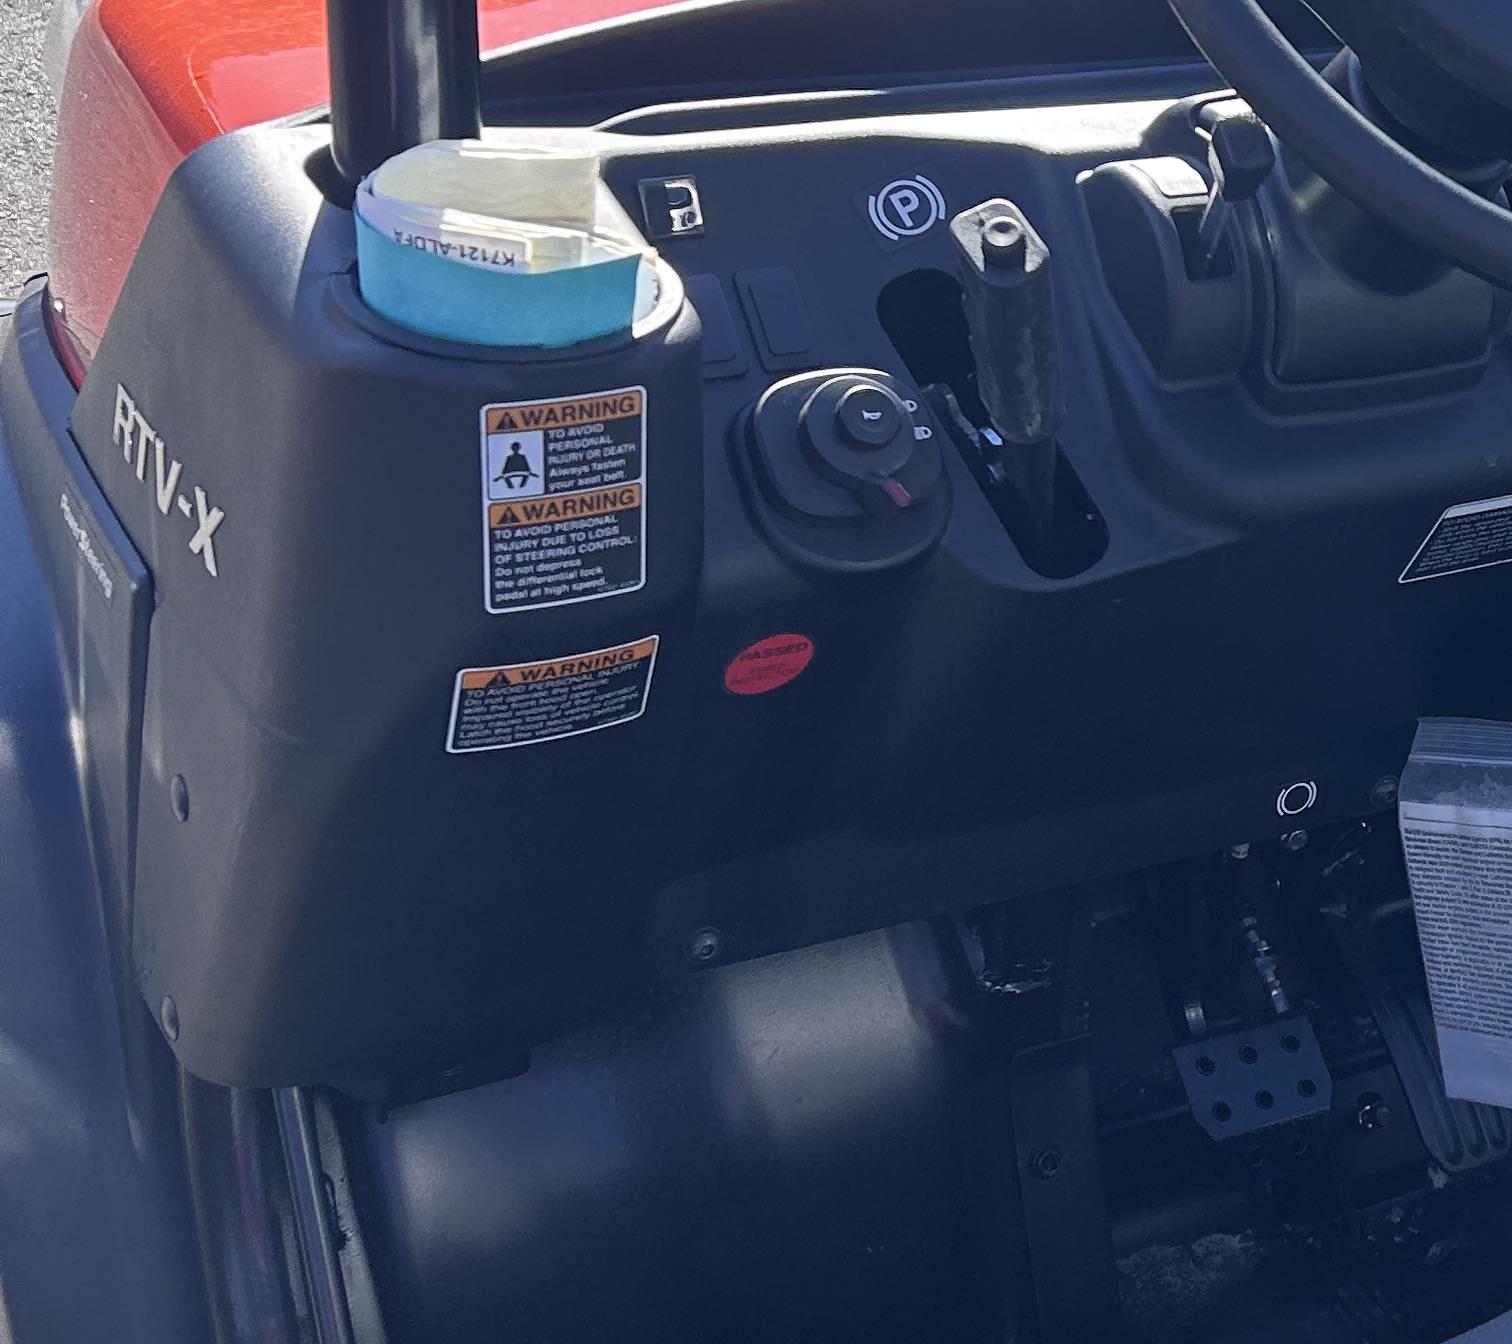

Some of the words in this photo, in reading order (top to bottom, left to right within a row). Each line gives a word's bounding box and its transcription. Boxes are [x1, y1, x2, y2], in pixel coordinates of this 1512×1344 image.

[520, 396, 635, 426] WARNING
[549, 429, 566, 439] TO
[567, 424, 605, 437] AVOID
[549, 435, 613, 452] PERSONAL
[586, 448, 602, 459] OR
[602, 443, 636, 456] DEATH
[113, 383, 224, 577] RTV-X
[522, 489, 635, 519] WARNING
[494, 529, 512, 539] TO
[514, 525, 552, 539] AVOID
[554, 515, 618, 532] PERSONAL
[494, 539, 540, 552] INJURY
[541, 535, 567, 547] DUE
[569, 532, 586, 543] TO
[588, 526, 619, 540] LOSS
[494, 554, 512, 564] OF
[514, 546, 576, 562] STEERING
[520, 649, 635, 681] WARNING
